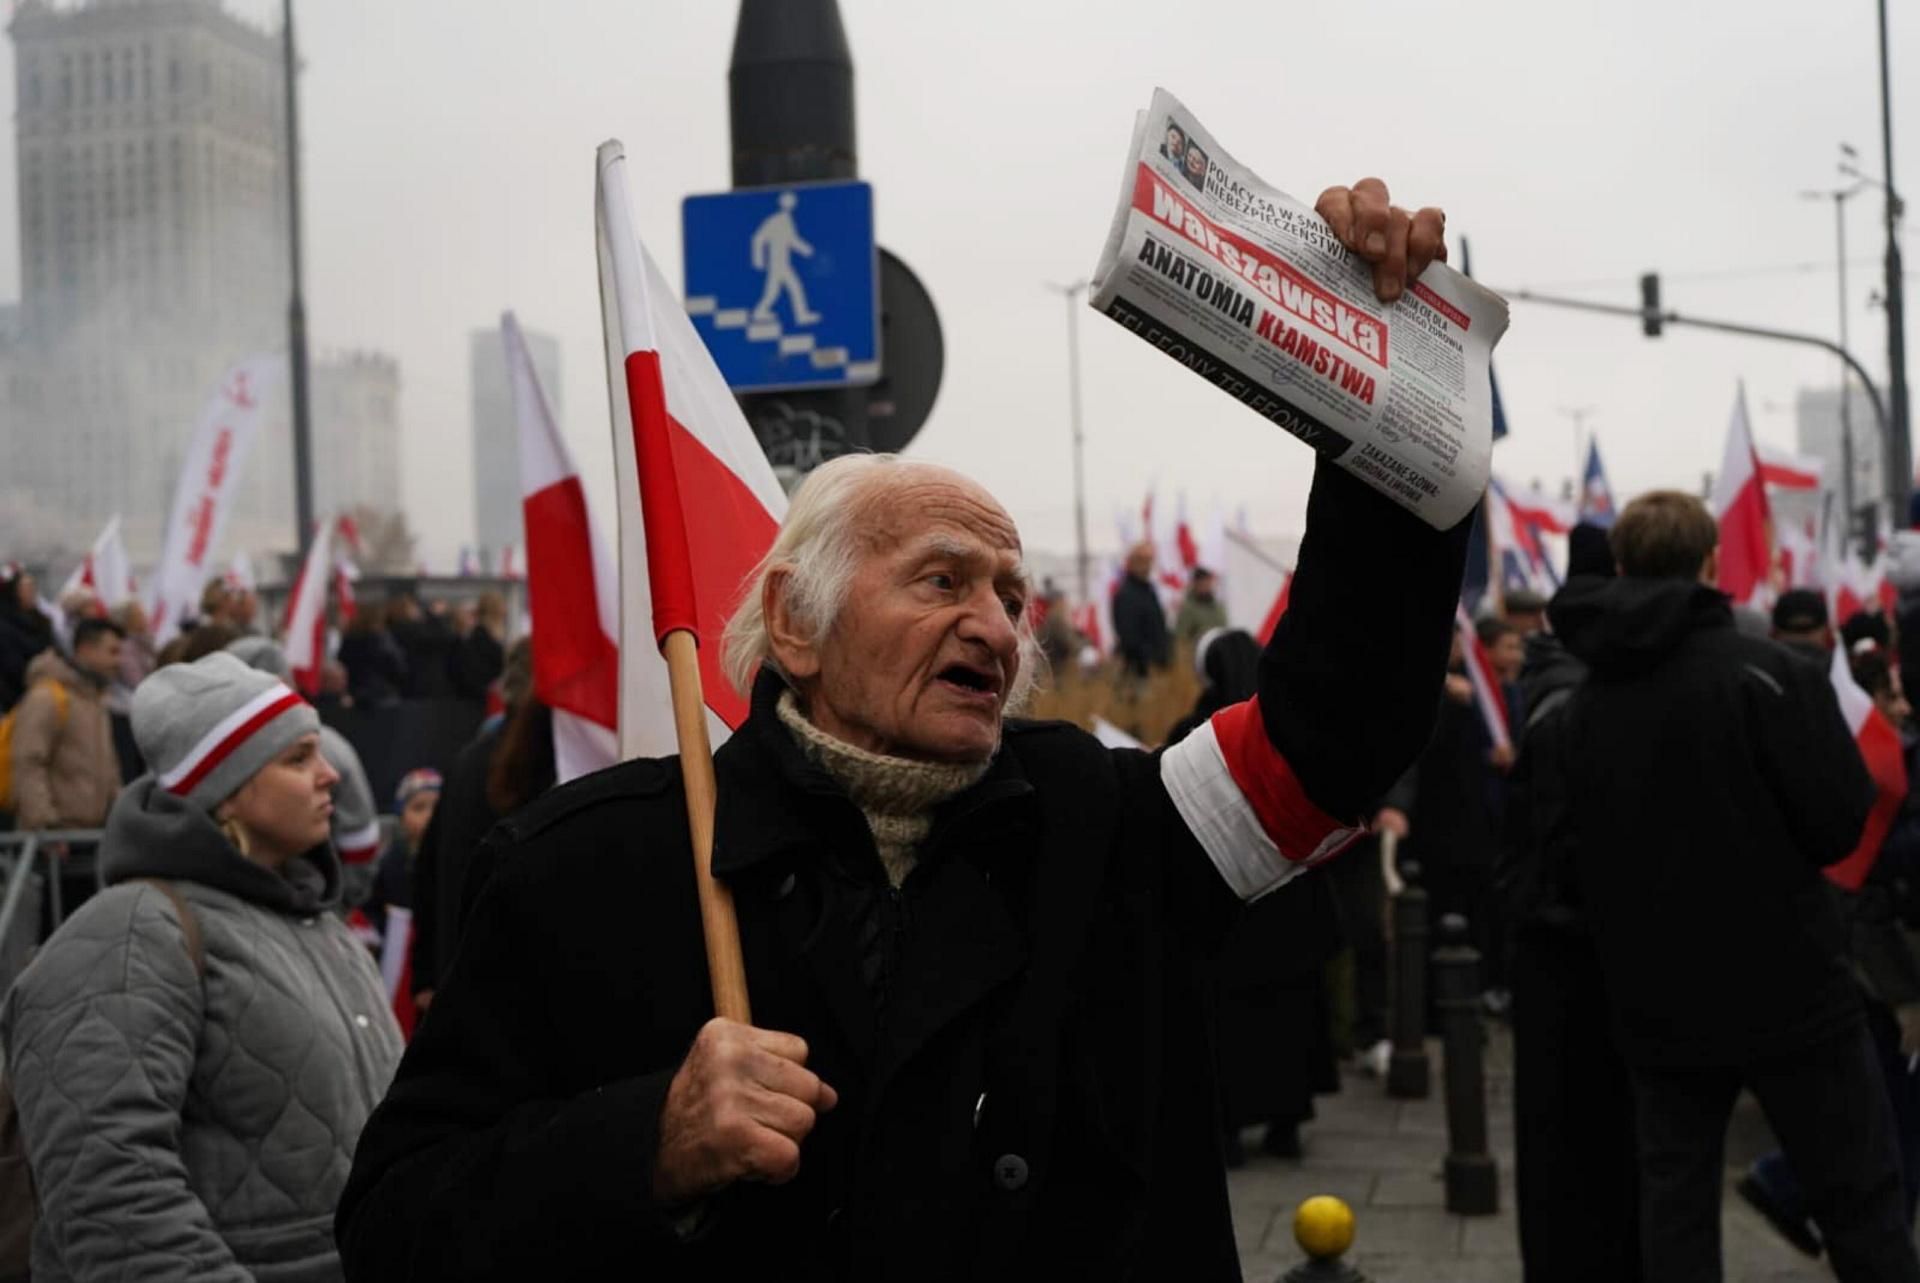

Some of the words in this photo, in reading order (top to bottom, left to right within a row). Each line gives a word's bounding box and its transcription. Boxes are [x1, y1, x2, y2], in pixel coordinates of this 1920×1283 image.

[1153, 182, 1380, 361] Warszawska
[1208, 161, 1255, 205] POLACY
[1258, 199, 1276, 218] SĄ
[1279, 207, 1293, 220] W
[1297, 214, 1337, 239] ŚMIE
[1138, 238, 1256, 329] ANATOMIA
[1256, 309, 1376, 405] KŁAMSTWA
